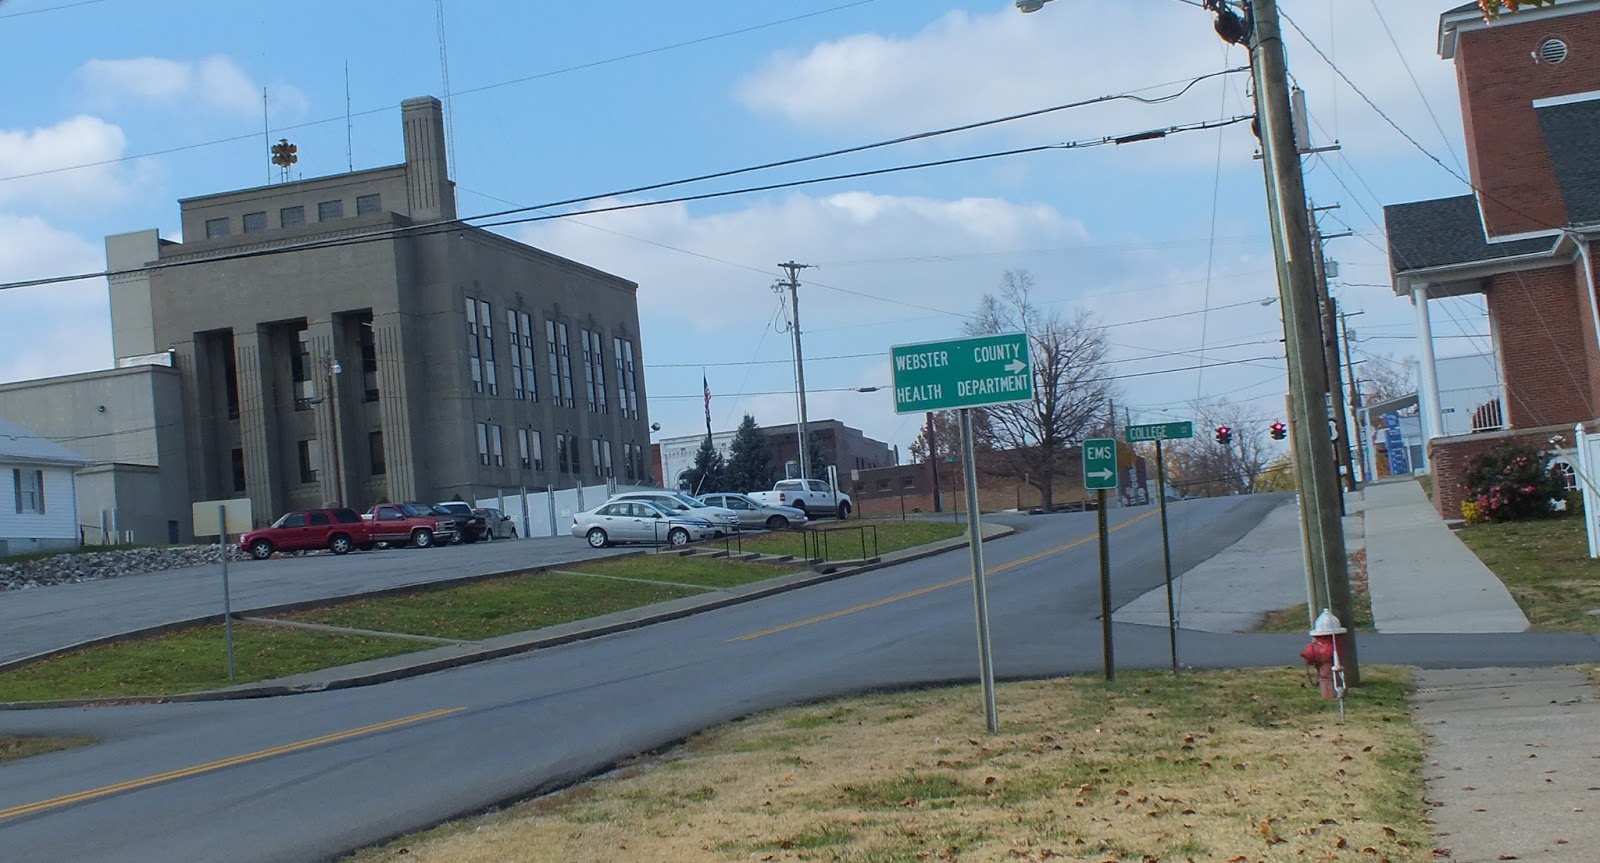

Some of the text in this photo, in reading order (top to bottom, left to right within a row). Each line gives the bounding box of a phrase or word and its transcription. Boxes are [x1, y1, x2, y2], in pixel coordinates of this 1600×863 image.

[895, 343, 1020, 371] WEBSTER COUNTY
[897, 374, 1028, 403] HEALTH DEPARTMENT
[1130, 425, 1167, 440] COLLEGE
[1087, 446, 1112, 460] EMS
